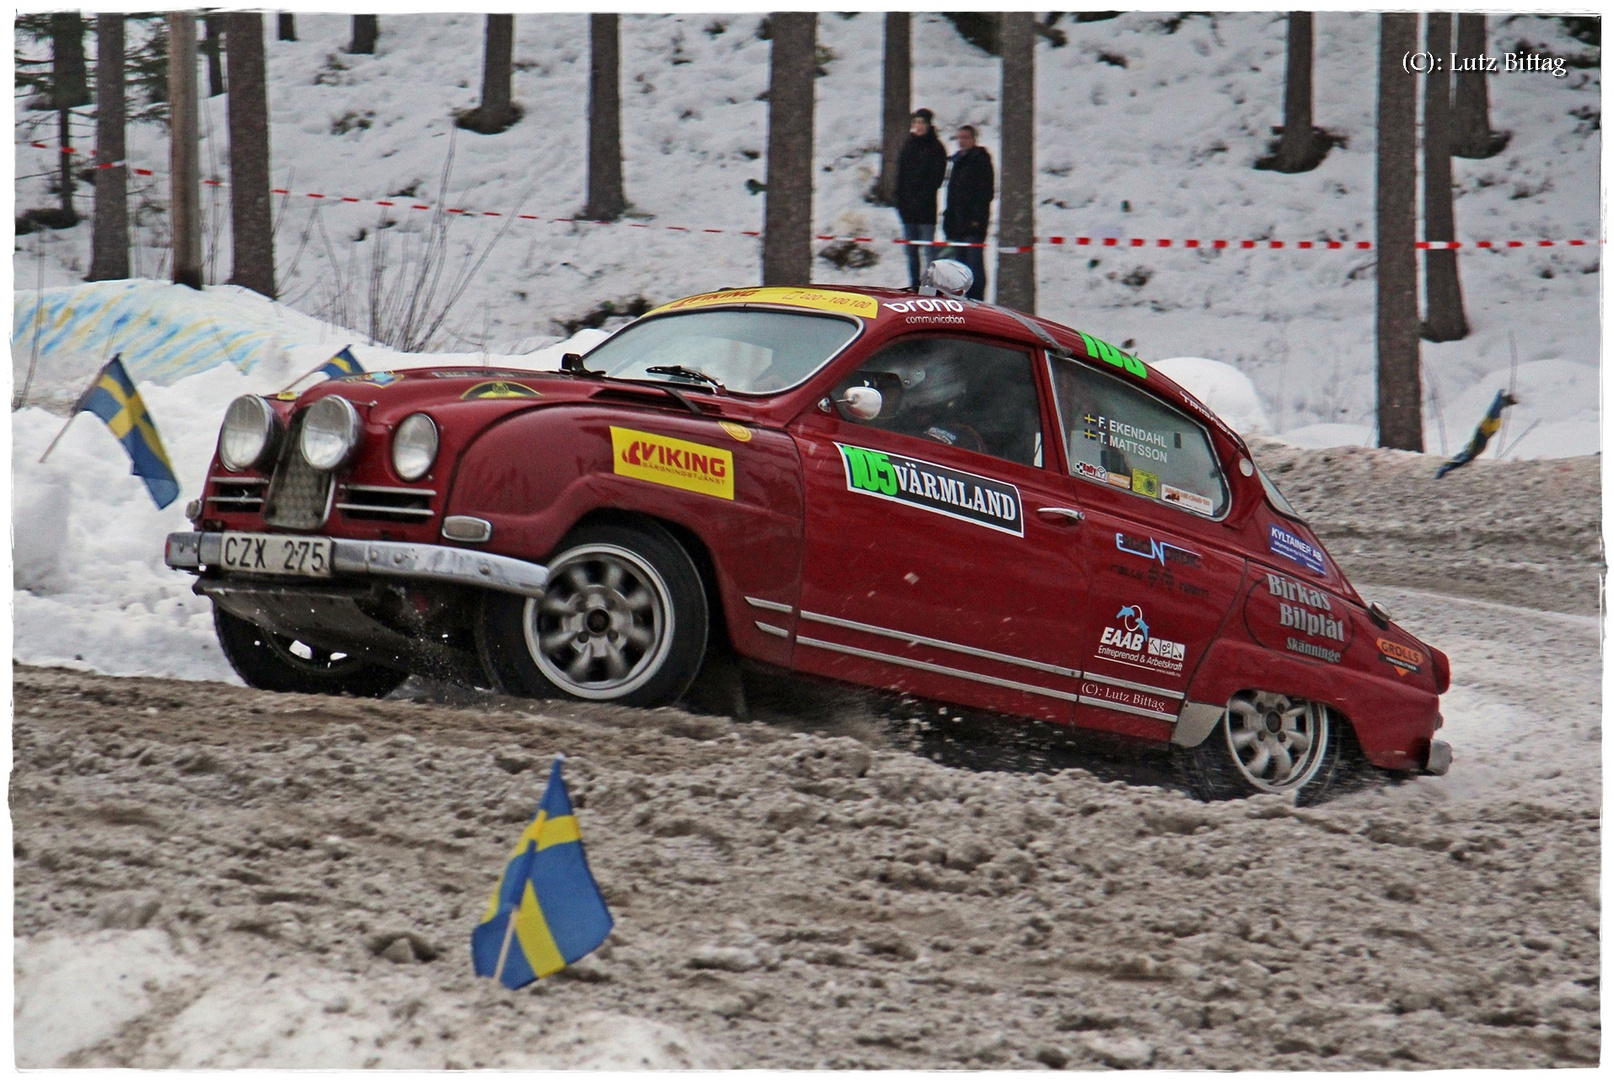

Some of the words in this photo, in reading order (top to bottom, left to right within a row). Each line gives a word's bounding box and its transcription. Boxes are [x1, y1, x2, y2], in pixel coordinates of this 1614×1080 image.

[829, 296, 850, 305] 100
[849, 300, 872, 309] 100
[882, 299, 964, 313] brono
[905, 315, 966, 324] communication
[1098, 416, 1107, 430] F.
[1109, 419, 1168, 449] EKENDAHL
[1098, 431, 1107, 446] T.
[1109, 435, 1168, 464] MATTSSON
[640, 441, 726, 479] VIKING
[842, 445, 898, 496] 105
[892, 461, 1016, 522] VÄRMLAND
[224, 536, 267, 569] CZX
[283, 540, 325, 572] 275
[1271, 526, 1312, 556] KYLTAINER
[1312, 548, 1323, 562] AB
[1266, 572, 1332, 612] Birkas
[1279, 602, 1345, 642] Bilplåt
[1100, 626, 1144, 652] EAAB
[1286, 636, 1341, 664] Skänninge
[1381, 641, 1419, 663] GROLLS
[1139, 654, 1146, 663] &
[1146, 657, 1183, 671] Arbetskraft
